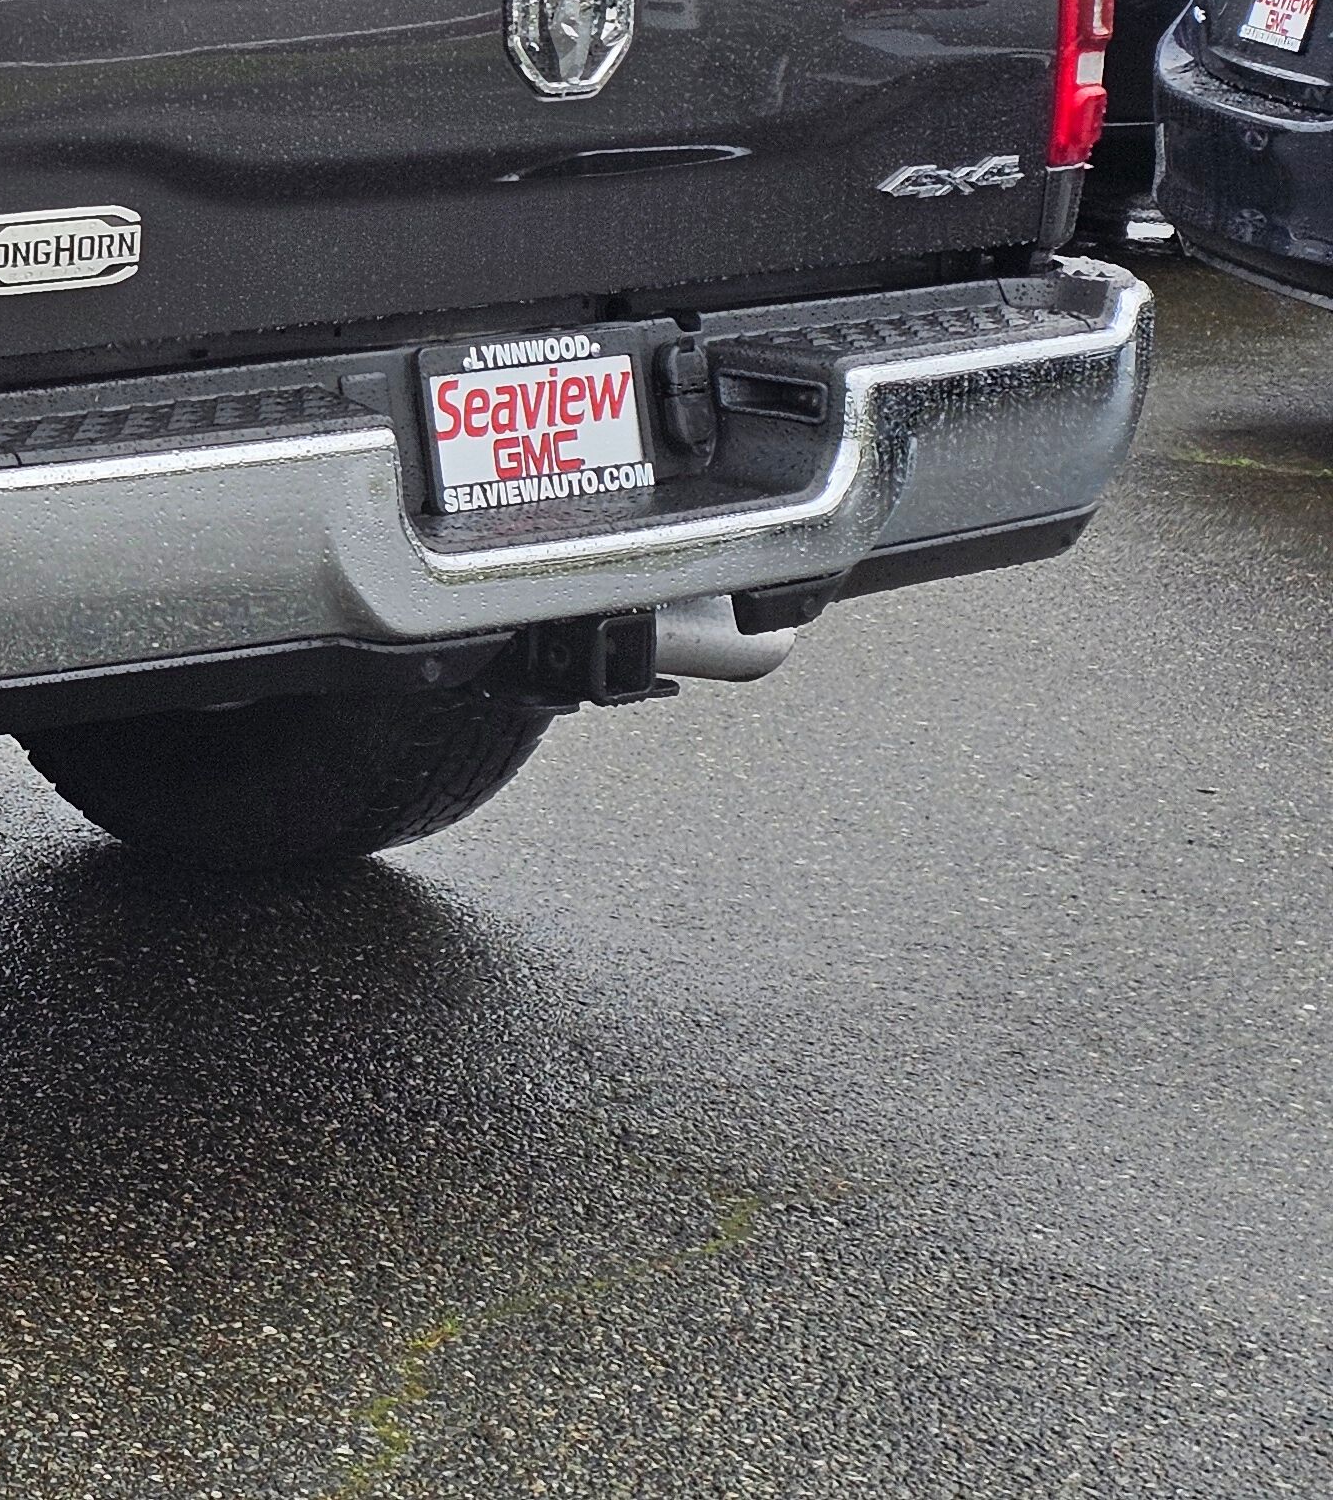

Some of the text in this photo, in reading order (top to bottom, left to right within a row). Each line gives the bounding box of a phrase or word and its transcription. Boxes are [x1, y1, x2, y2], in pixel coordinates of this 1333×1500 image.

[1265, 9, 1293, 36] GMC
[470, 334, 591, 369] LYNNWOOD
[436, 367, 631, 441] Seaview
[493, 428, 585, 481] GMC
[443, 462, 656, 513] SEAVIEWAUTO.COM
